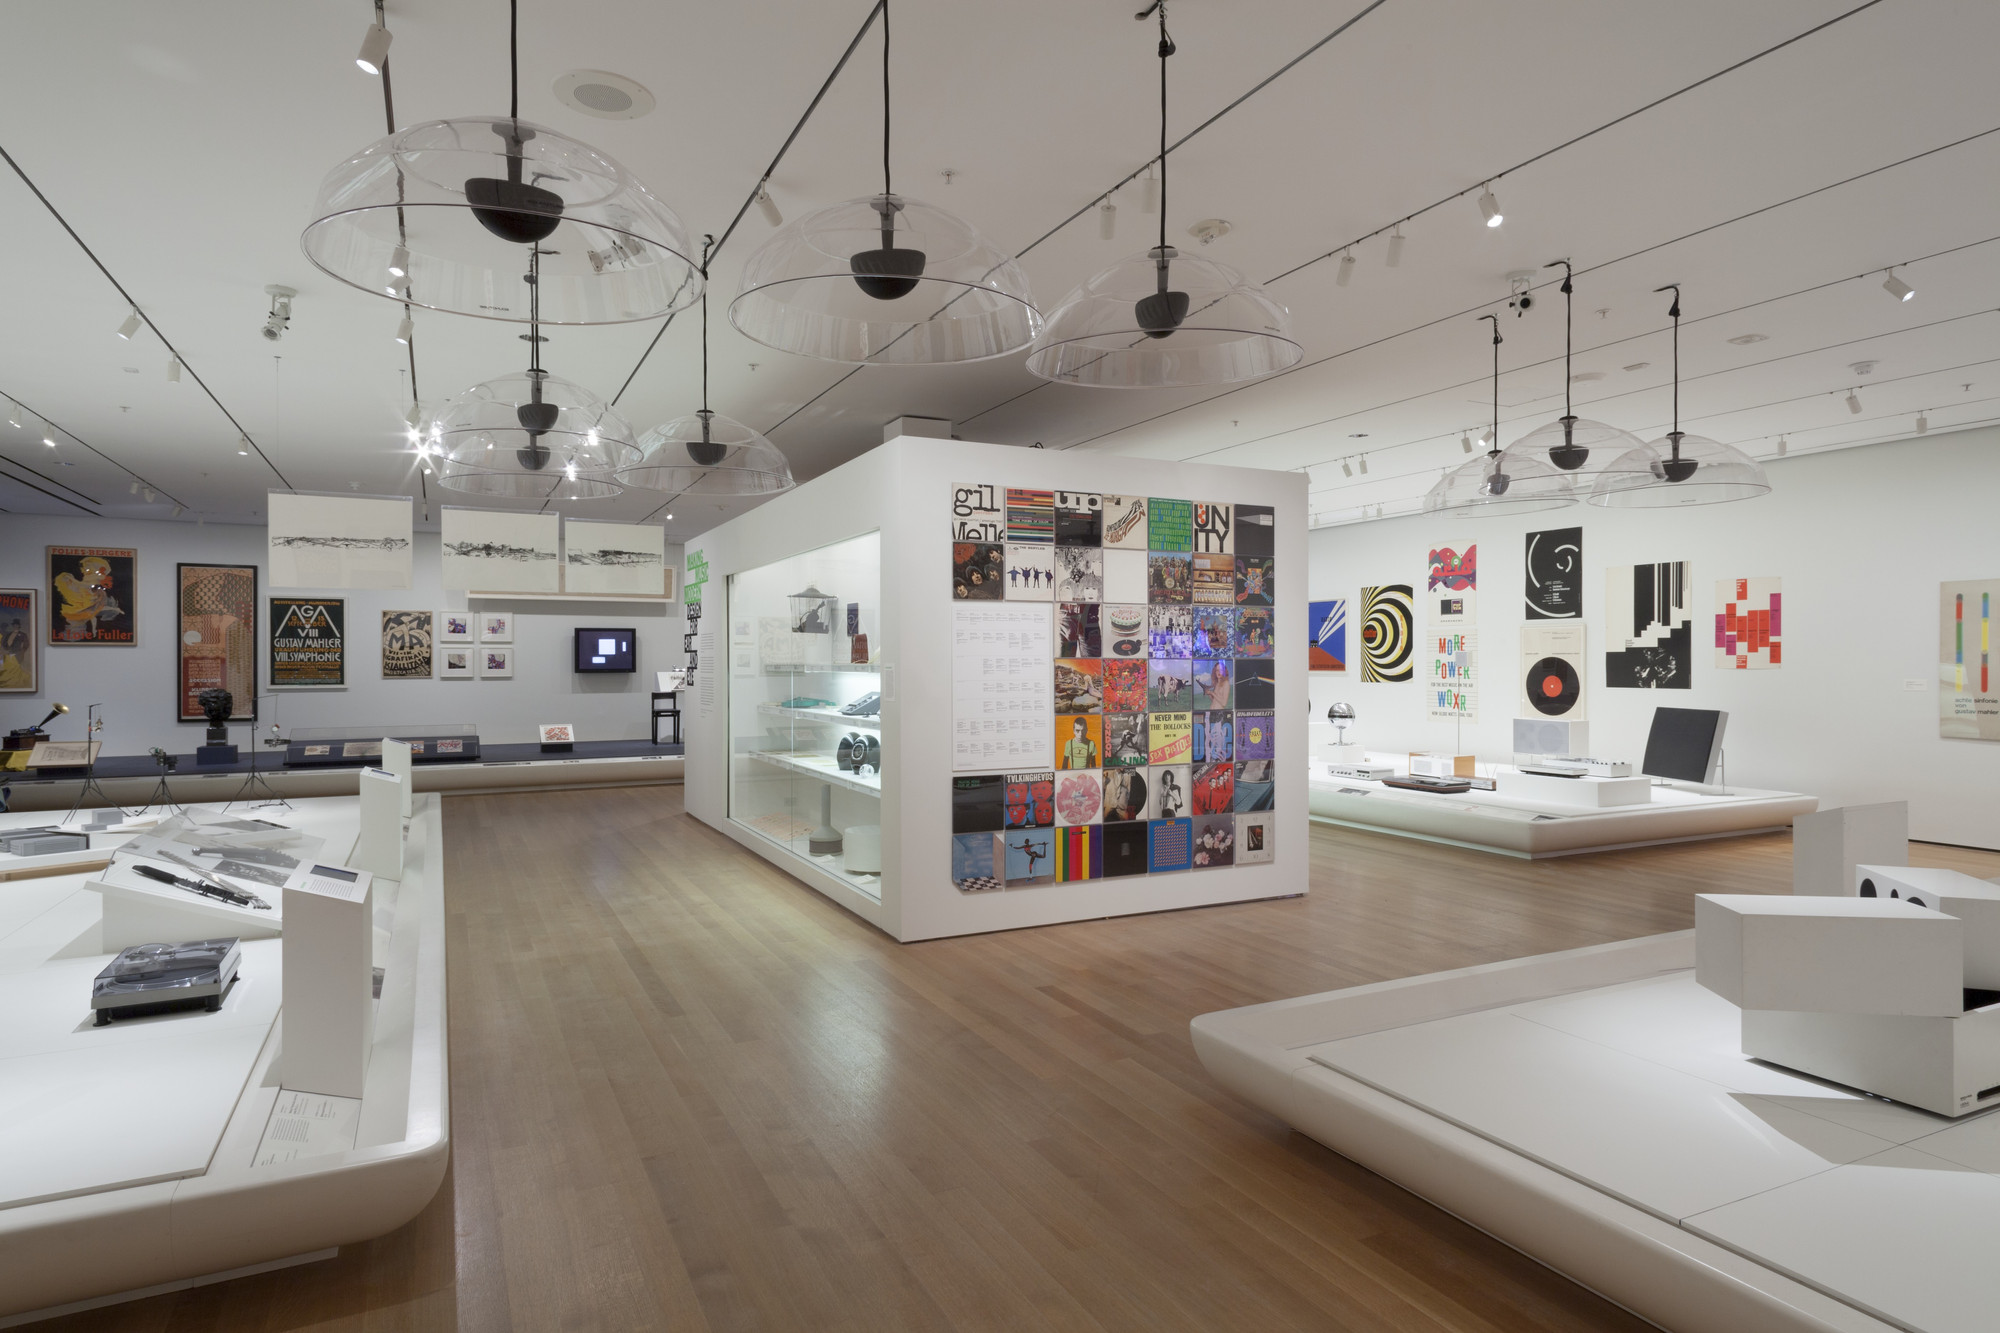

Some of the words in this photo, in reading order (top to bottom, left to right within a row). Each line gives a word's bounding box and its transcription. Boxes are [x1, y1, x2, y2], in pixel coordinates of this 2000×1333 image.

[954, 484, 1000, 516] gil
[1055, 492, 1102, 514] up
[52, 629, 64, 640] La
[97, 629, 133, 640] Fuller
[274, 638, 304, 648] GUSTAV
[305, 639, 341, 648] MAHLER
[1439, 634, 1466, 656] MORE
[1437, 689, 1467, 711] WQXR
[1155, 714, 1171, 722] NEVER
[1105, 756, 1146, 766] CALLING
